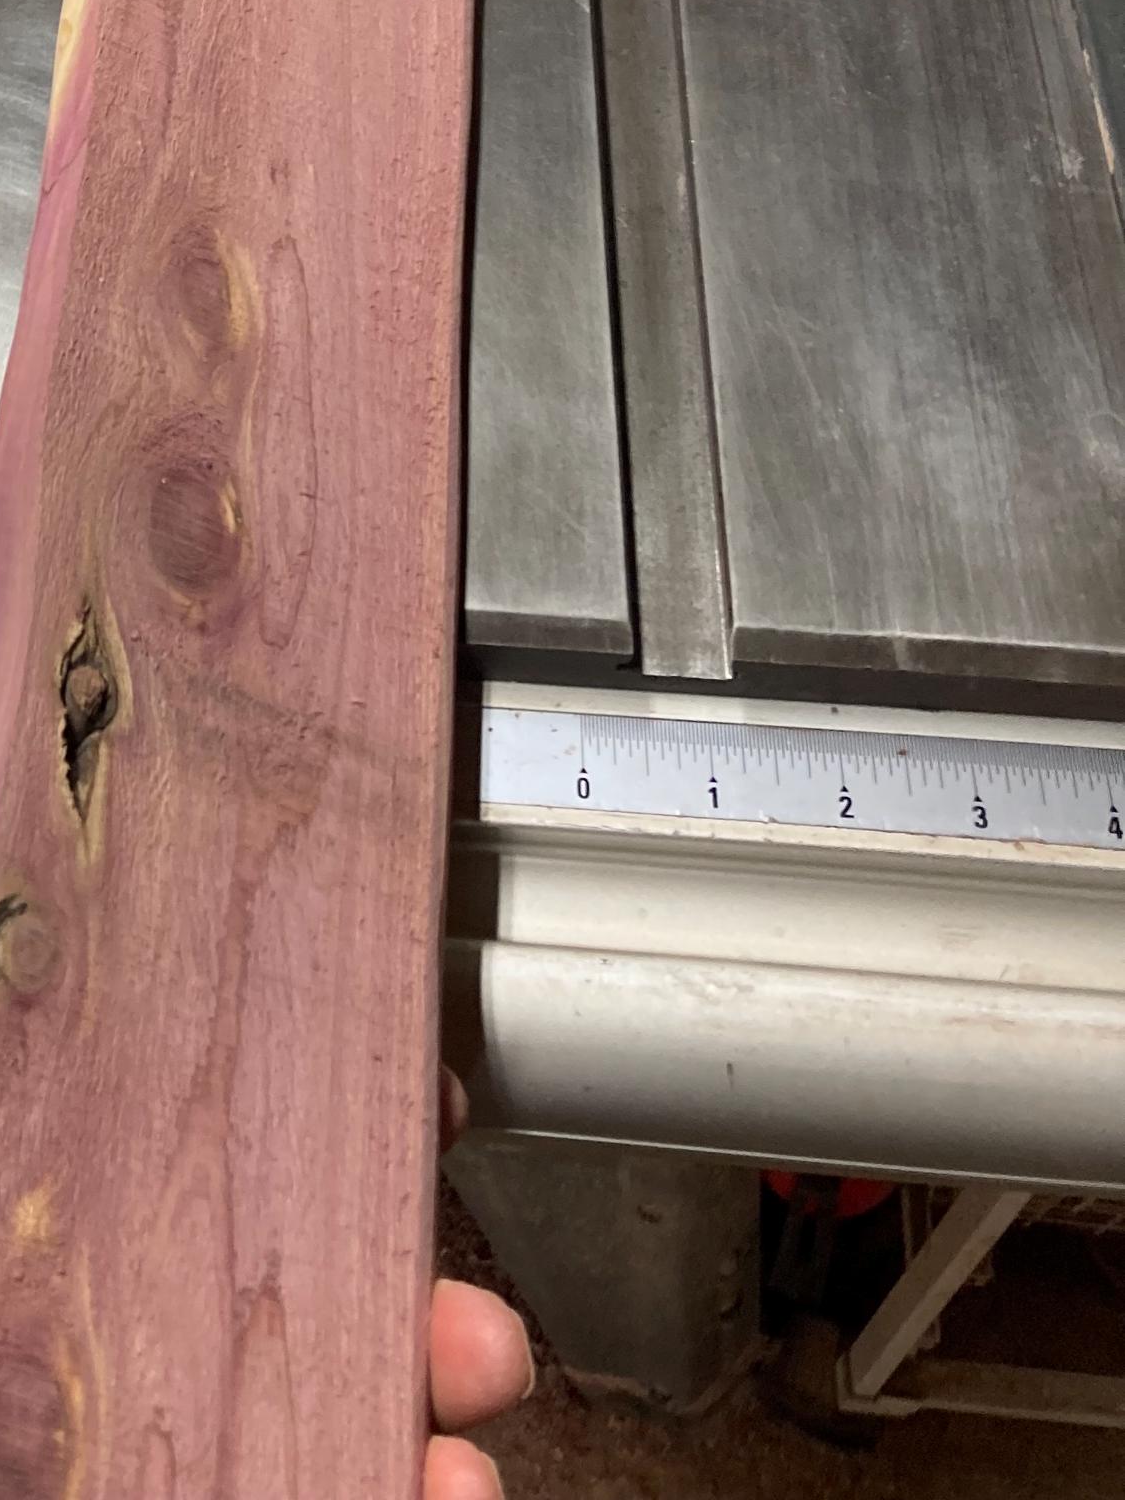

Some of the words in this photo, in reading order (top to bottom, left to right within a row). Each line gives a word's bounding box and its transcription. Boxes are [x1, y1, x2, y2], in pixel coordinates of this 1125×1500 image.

[576, 777, 590, 799] 0
[707, 786, 719, 809] 1
[838, 796, 854, 819] 2
[971, 806, 989, 829] 3
[1107, 817, 1124, 840] 4
